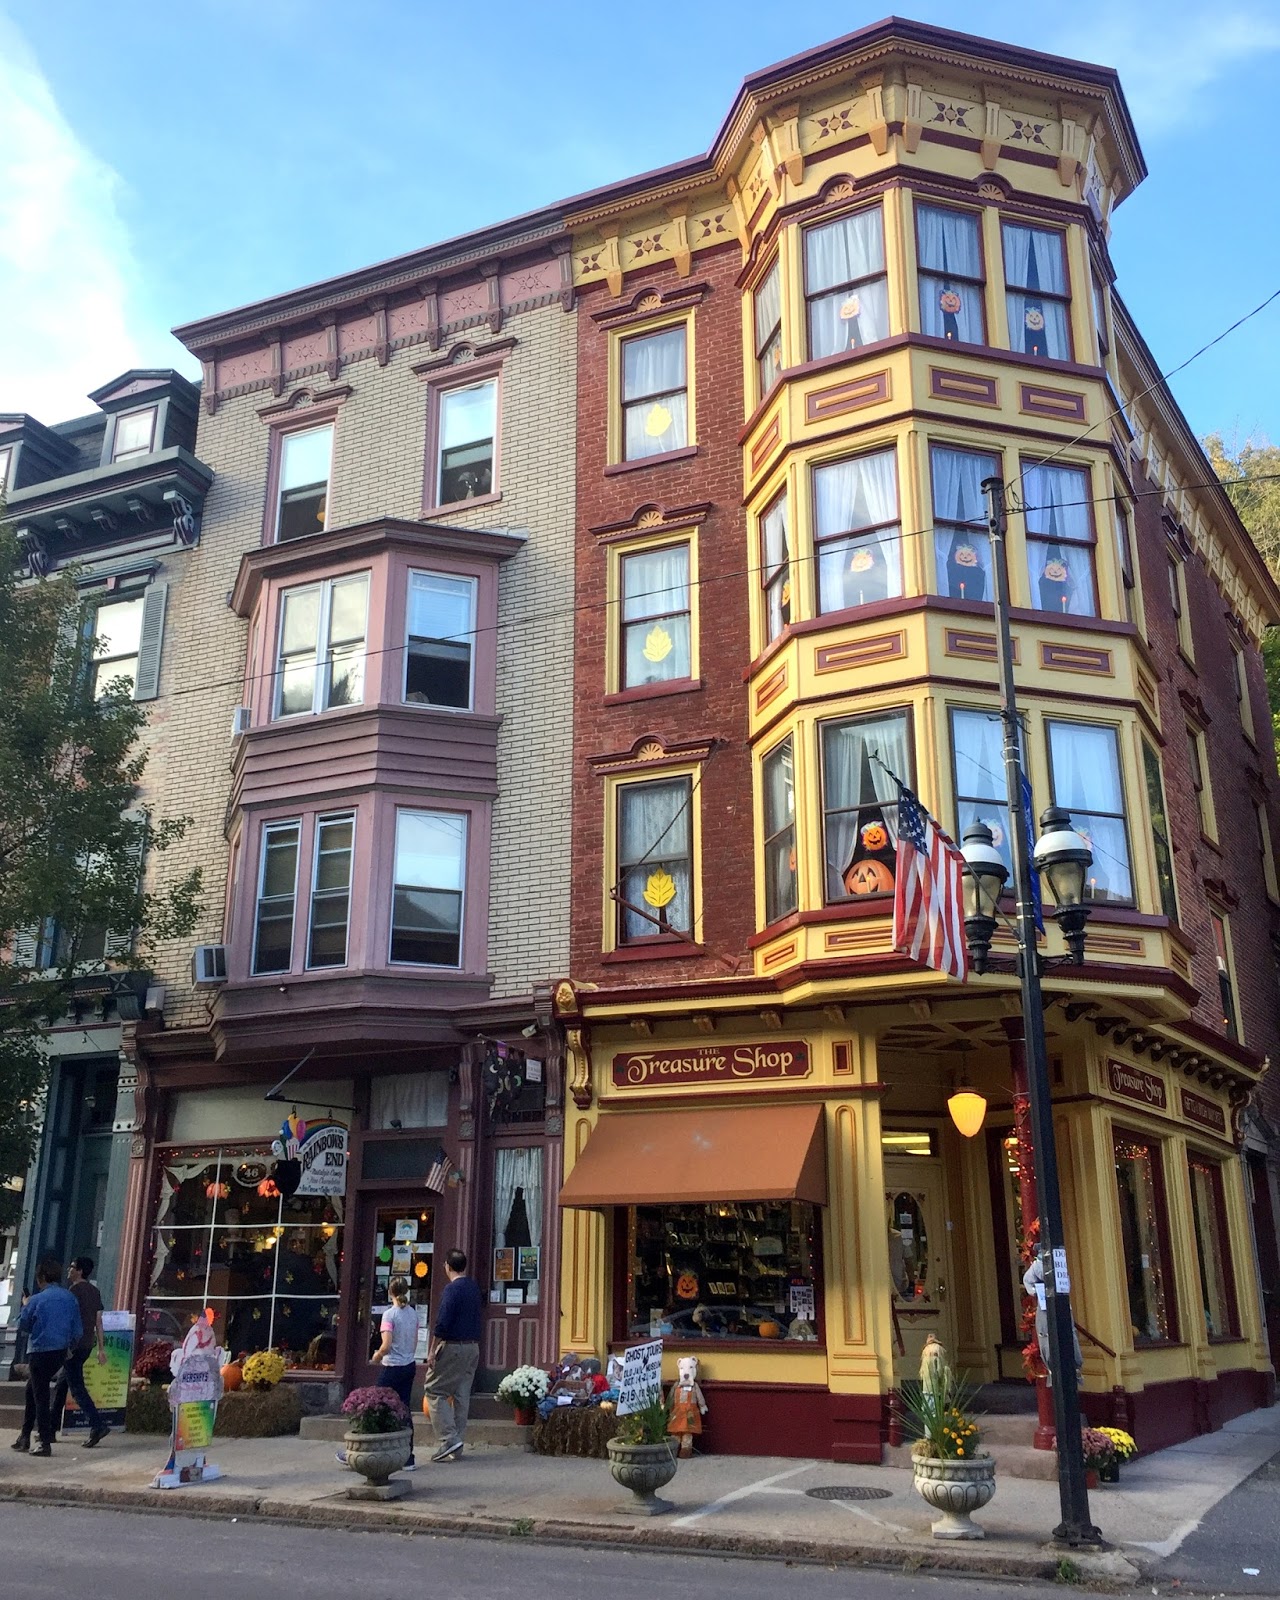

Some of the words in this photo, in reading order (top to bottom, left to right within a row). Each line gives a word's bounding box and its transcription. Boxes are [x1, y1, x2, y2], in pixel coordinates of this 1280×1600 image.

[697, 1048, 720, 1056] THE
[627, 1054, 726, 1083] Treasure
[732, 1046, 793, 1076] Shop
[1113, 1064, 1144, 1092] Treasure
[1144, 1075, 1163, 1106] Shop
[325, 1152, 344, 1167] END
[245, 1168, 259, 1178] 46
[626, 1349, 645, 1363] GHOST
[647, 1343, 662, 1357] TOURS
